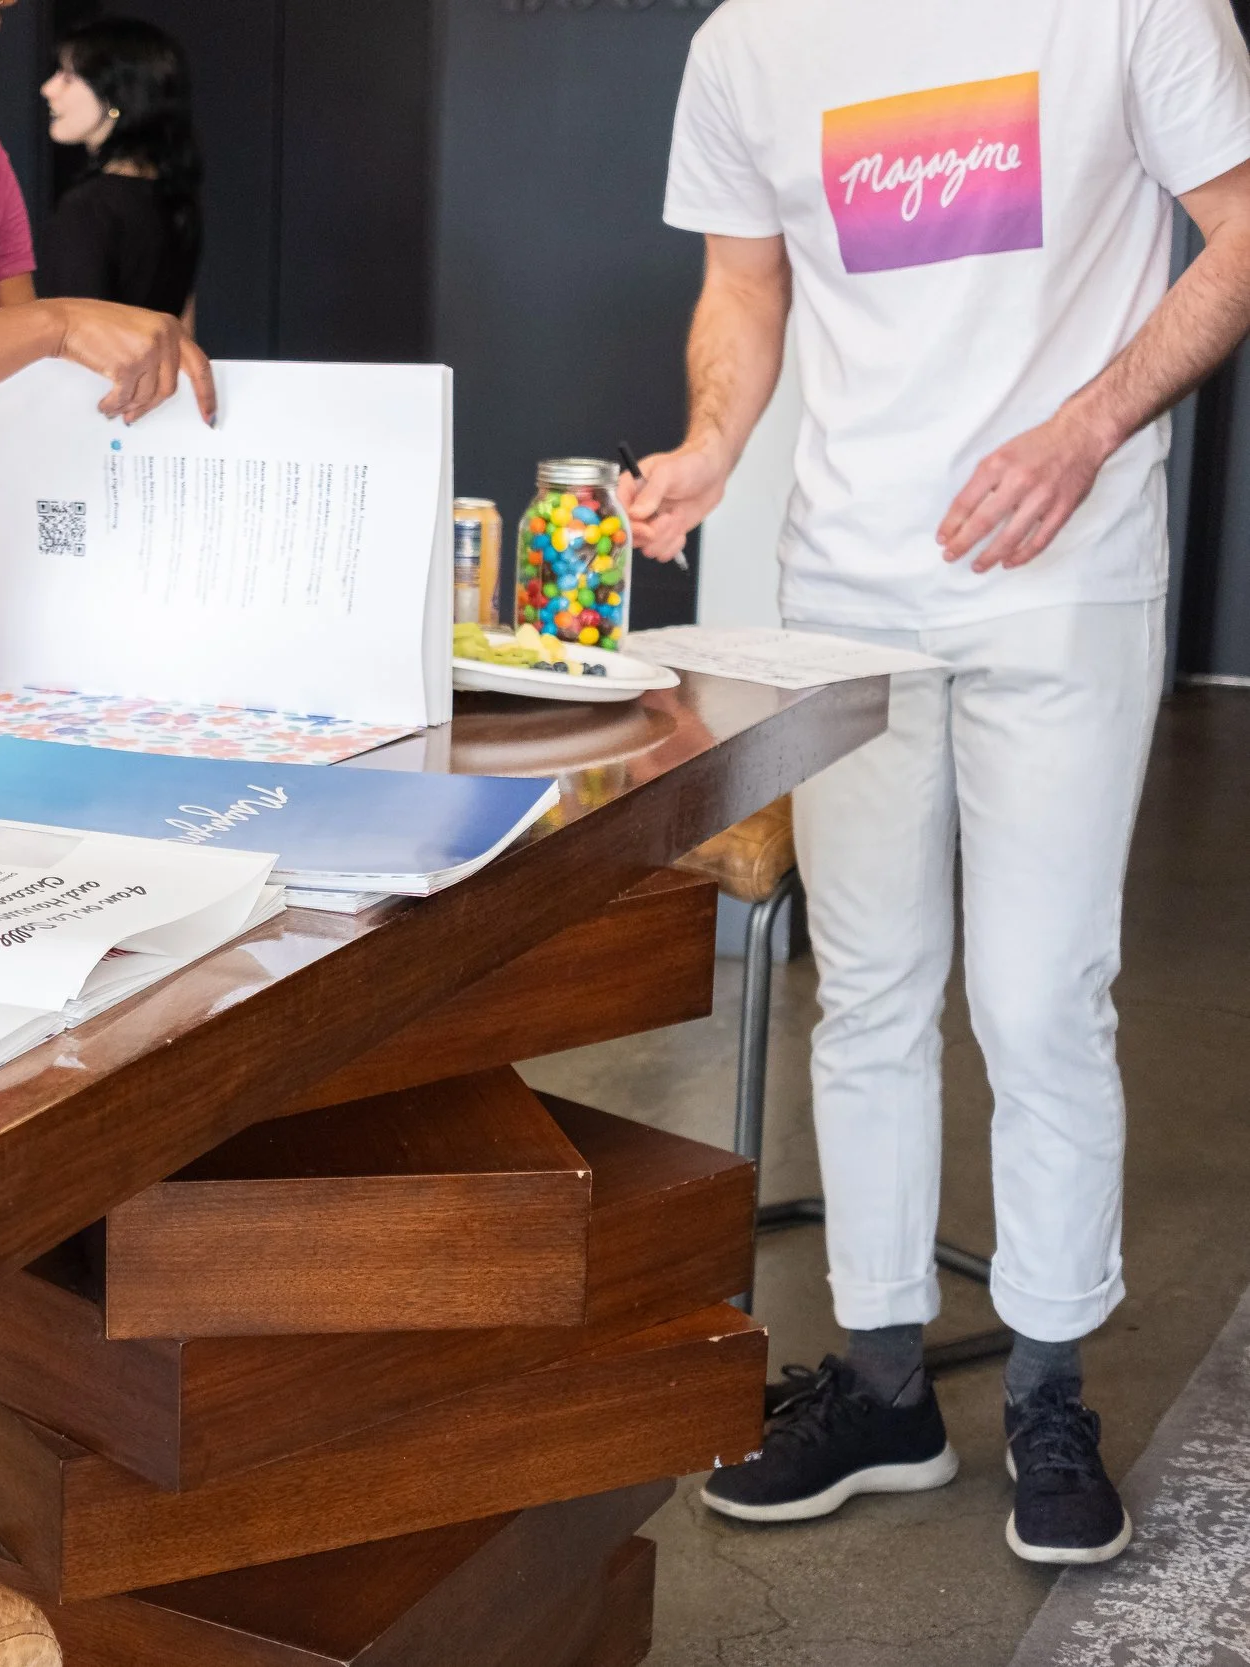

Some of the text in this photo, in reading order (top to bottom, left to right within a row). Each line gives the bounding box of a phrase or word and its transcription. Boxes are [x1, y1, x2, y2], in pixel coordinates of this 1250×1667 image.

[838, 137, 1022, 222] Magazine
[160, 783, 289, 844] Magazin
[59, 879, 102, 903] and
[72, 903, 104, 917] on
